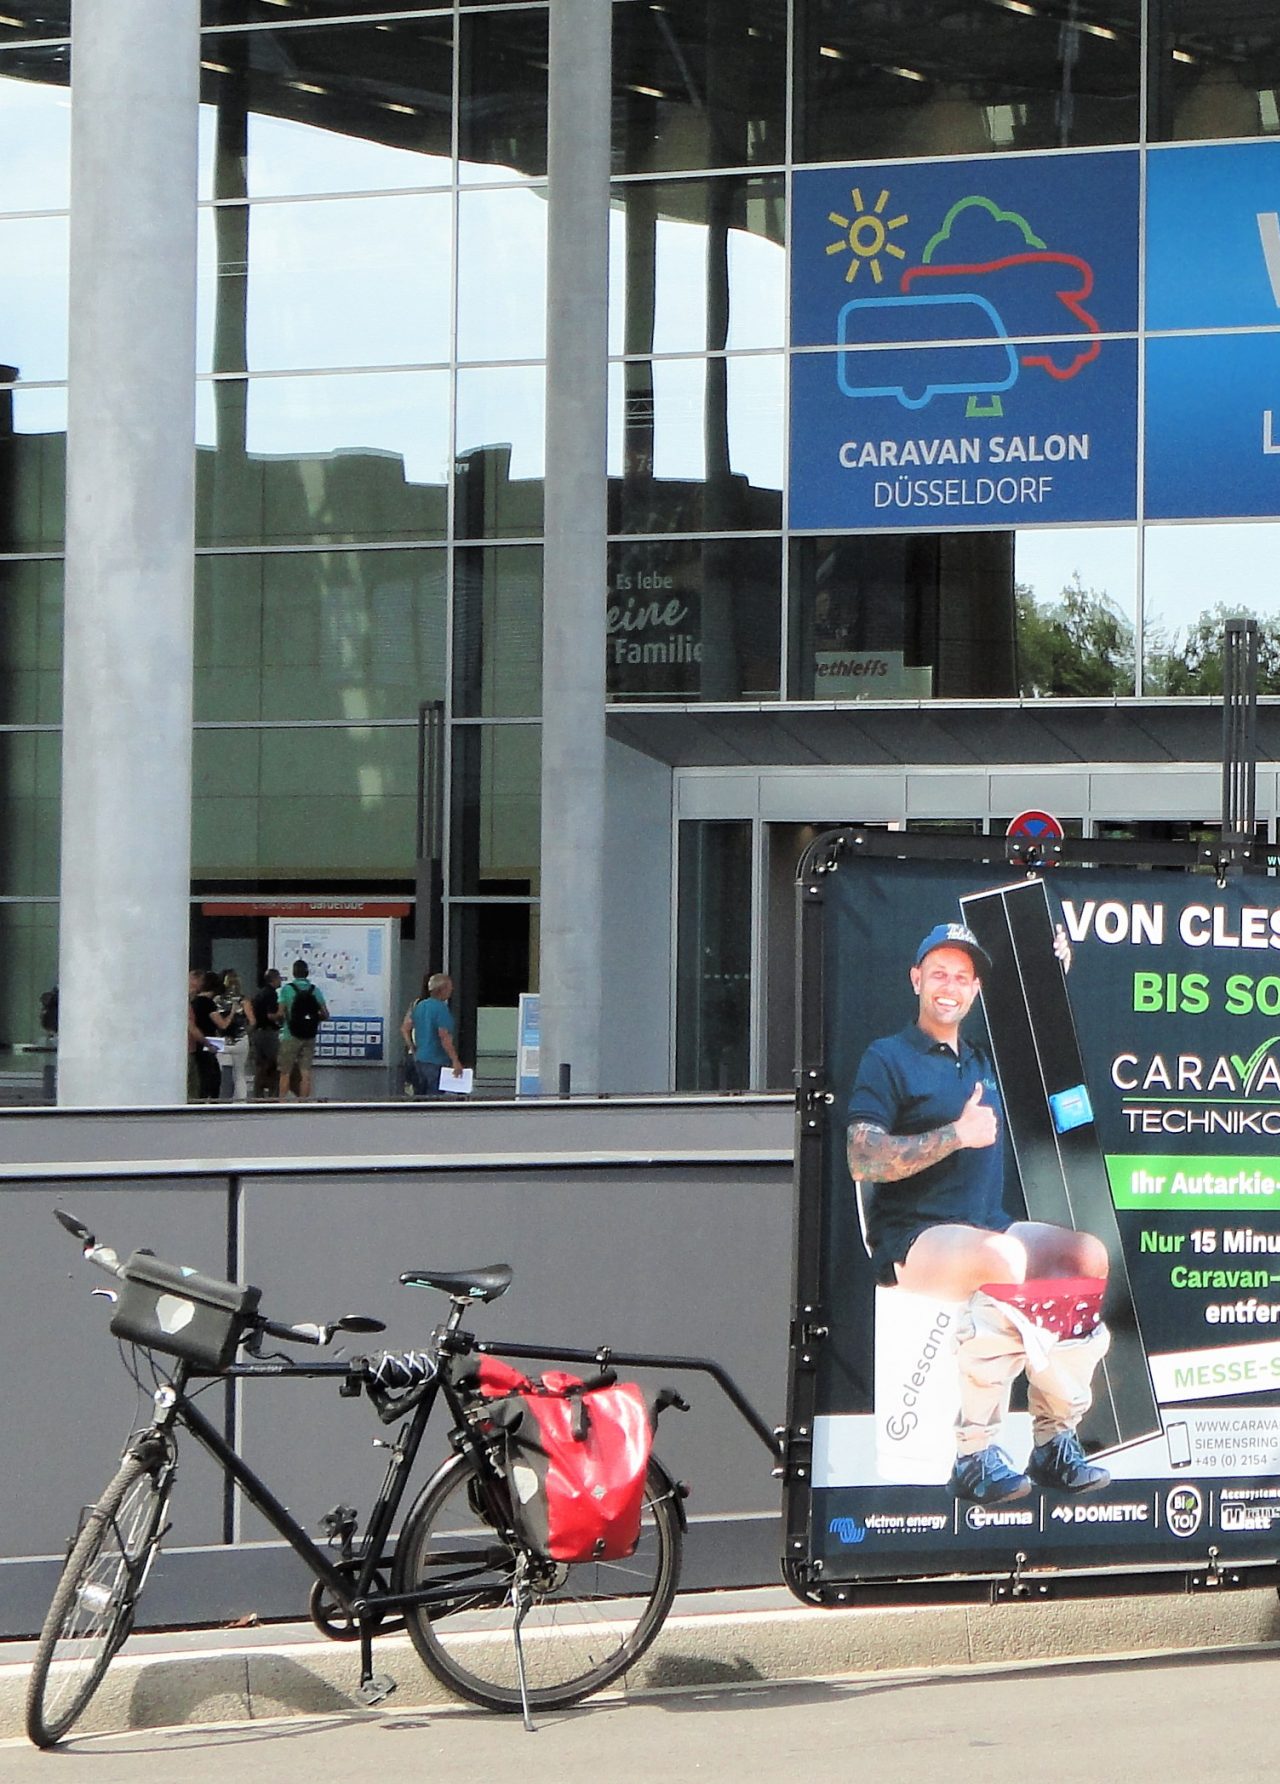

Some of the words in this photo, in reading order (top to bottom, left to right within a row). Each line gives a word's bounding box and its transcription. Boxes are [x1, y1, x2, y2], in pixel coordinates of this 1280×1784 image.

[839, 438, 979, 468] CARAVAN
[989, 434, 1089, 463] SALON
[874, 475, 1053, 508] DÜSSELDORF
[616, 574, 632, 590] Es
[637, 571, 673, 590] lebe
[1060, 900, 1164, 945] VON
[1133, 971, 1210, 1014] BIS
[1131, 1170, 1166, 1195] Ihr
[1140, 1231, 1186, 1253] Nur
[1190, 1231, 1216, 1253] 15
[902, 1311, 951, 1407] clesana
[1195, 1438, 1279, 1450] SIEMENSRING
[1195, 1455, 1217, 1467] +49
[1220, 1454, 1237, 1468] (0)
[1241, 1454, 1267, 1466] 2154
[865, 1515, 904, 1529] victron
[906, 1514, 947, 1530] energy
[968, 1507, 1032, 1527] truma
[1074, 1504, 1148, 1523] DOMETIC
